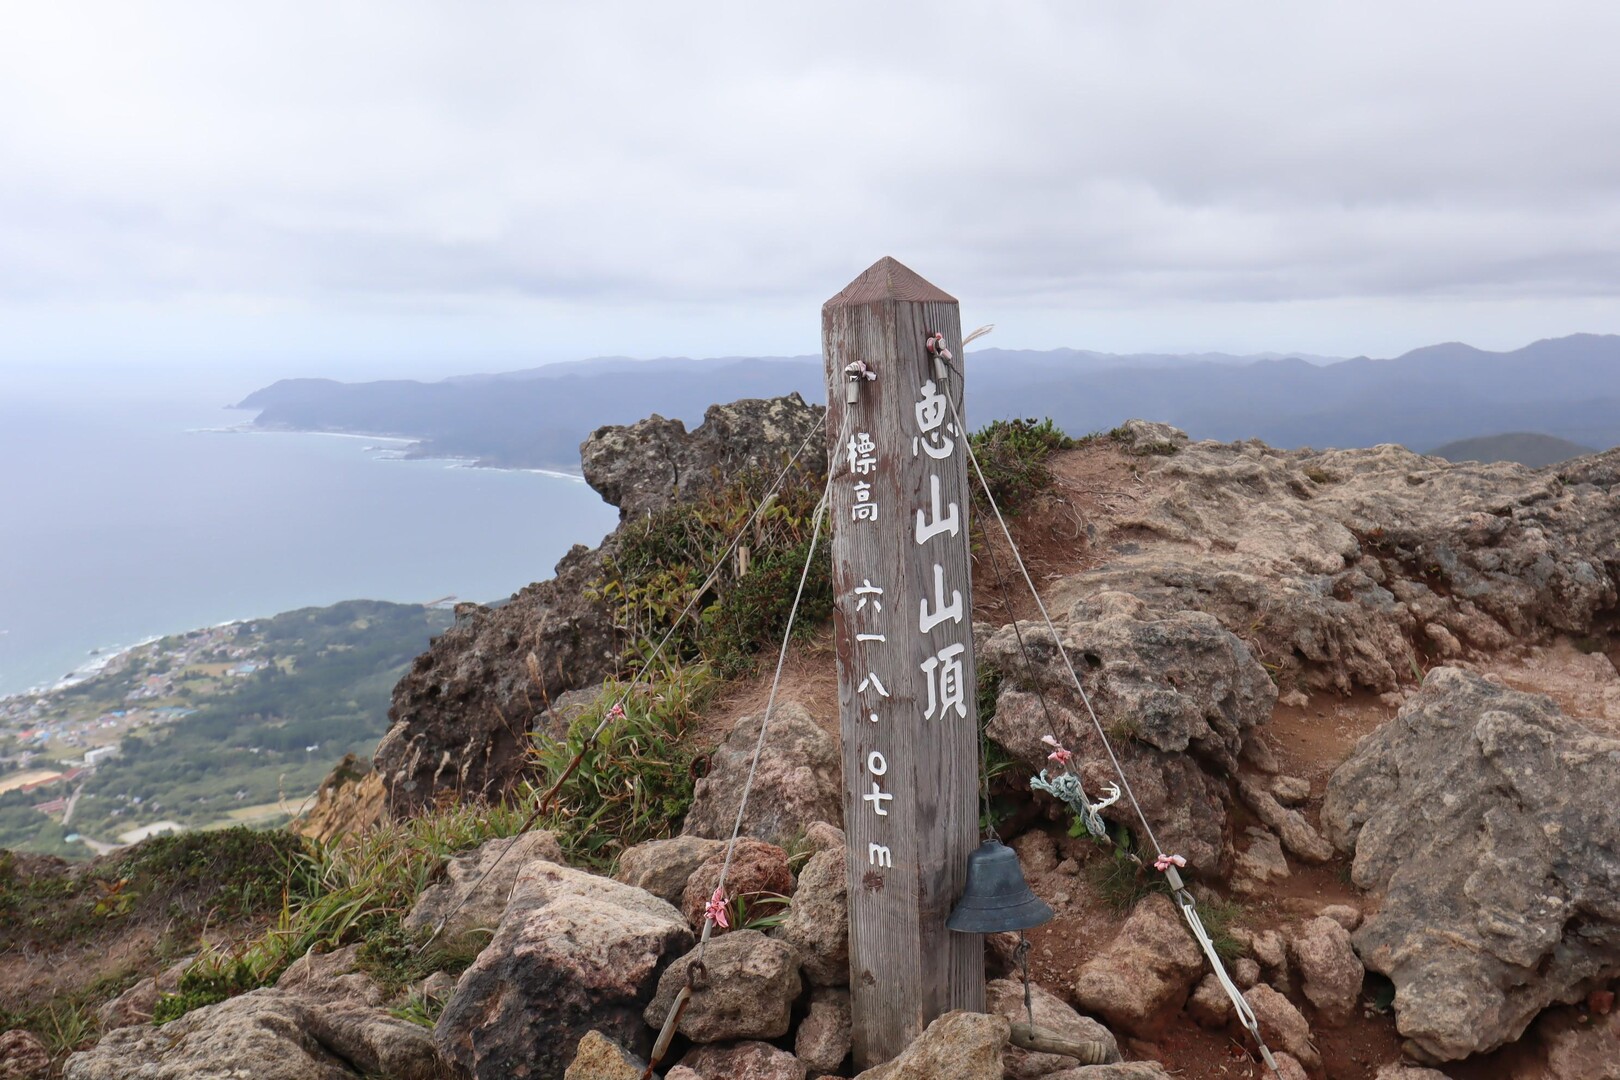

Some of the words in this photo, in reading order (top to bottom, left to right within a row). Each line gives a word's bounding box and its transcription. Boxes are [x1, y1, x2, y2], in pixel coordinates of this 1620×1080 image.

[846, 432, 878, 522] 標高
[912, 379, 967, 720] 恵山山頂
